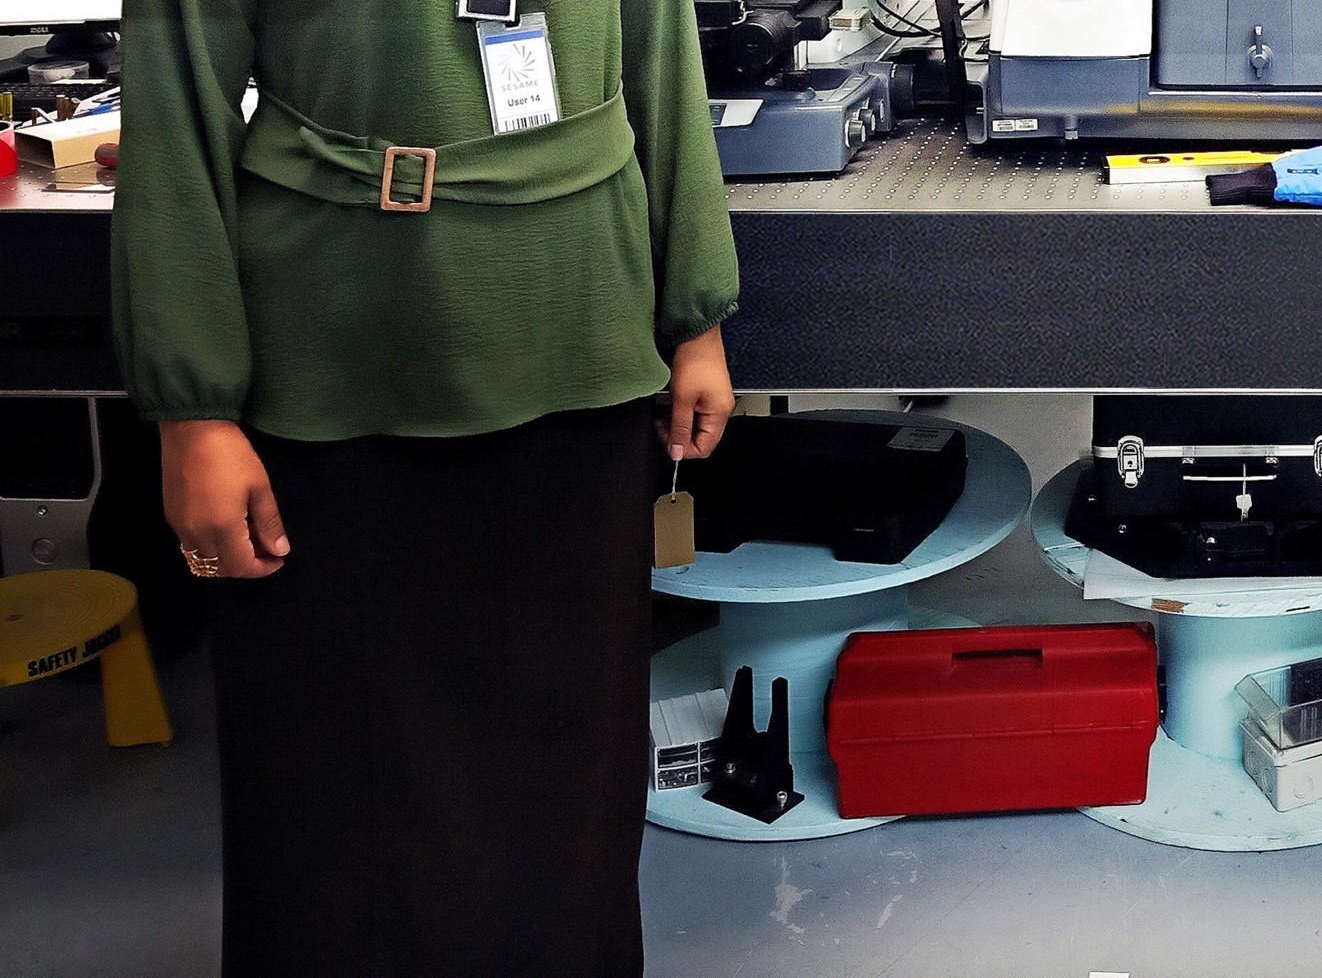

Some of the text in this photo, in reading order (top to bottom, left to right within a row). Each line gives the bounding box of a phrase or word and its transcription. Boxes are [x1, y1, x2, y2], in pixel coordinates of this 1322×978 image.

[501, 79, 540, 92] SESAME
[507, 94, 541, 107] User 14
[28, 646, 77, 677] SAFETY
